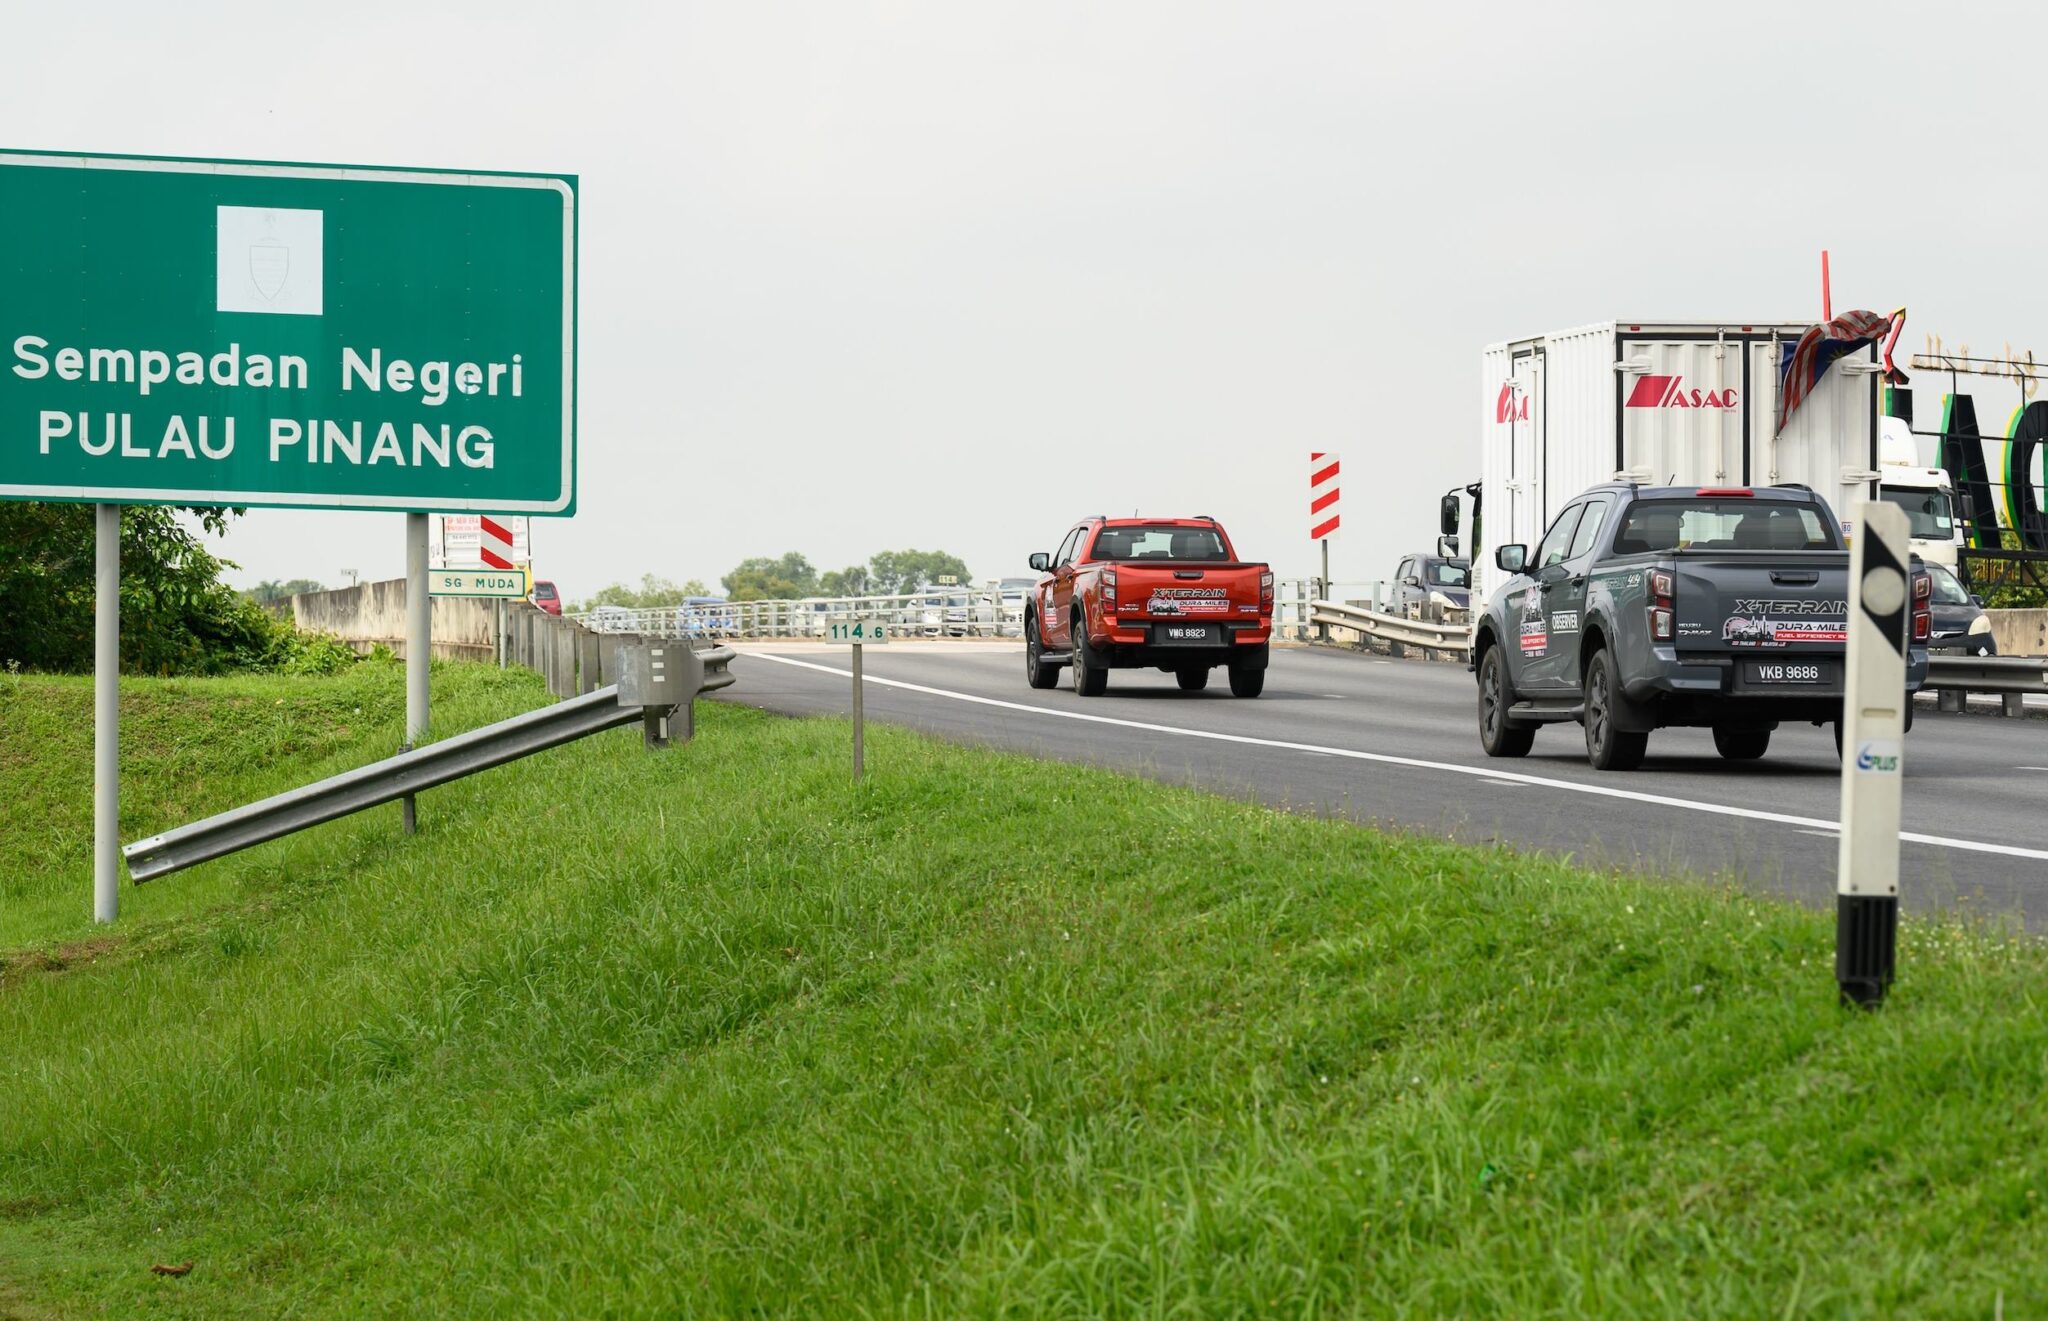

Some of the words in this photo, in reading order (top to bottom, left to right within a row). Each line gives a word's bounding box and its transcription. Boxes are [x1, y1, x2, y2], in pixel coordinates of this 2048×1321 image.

[12, 335, 308, 396] Sempadan
[342, 346, 522, 406] Negeri
[1671, 388, 1738, 408] ASAC
[40, 410, 235, 460] PULAU
[269, 418, 494, 469] PINANG
[444, 578, 462, 588] SG
[475, 578, 515, 589] MUDA
[1152, 588, 1227, 598] X-TERRAIN
[1552, 613, 1578, 630] OBSERVER
[1184, 628, 1206, 638] 8923
[1776, 631, 1795, 639] FUEL
[1795, 631, 1836, 639] EFFICIENCY
[1758, 666, 1783, 680] VKB
[1785, 666, 1819, 680] 9686
